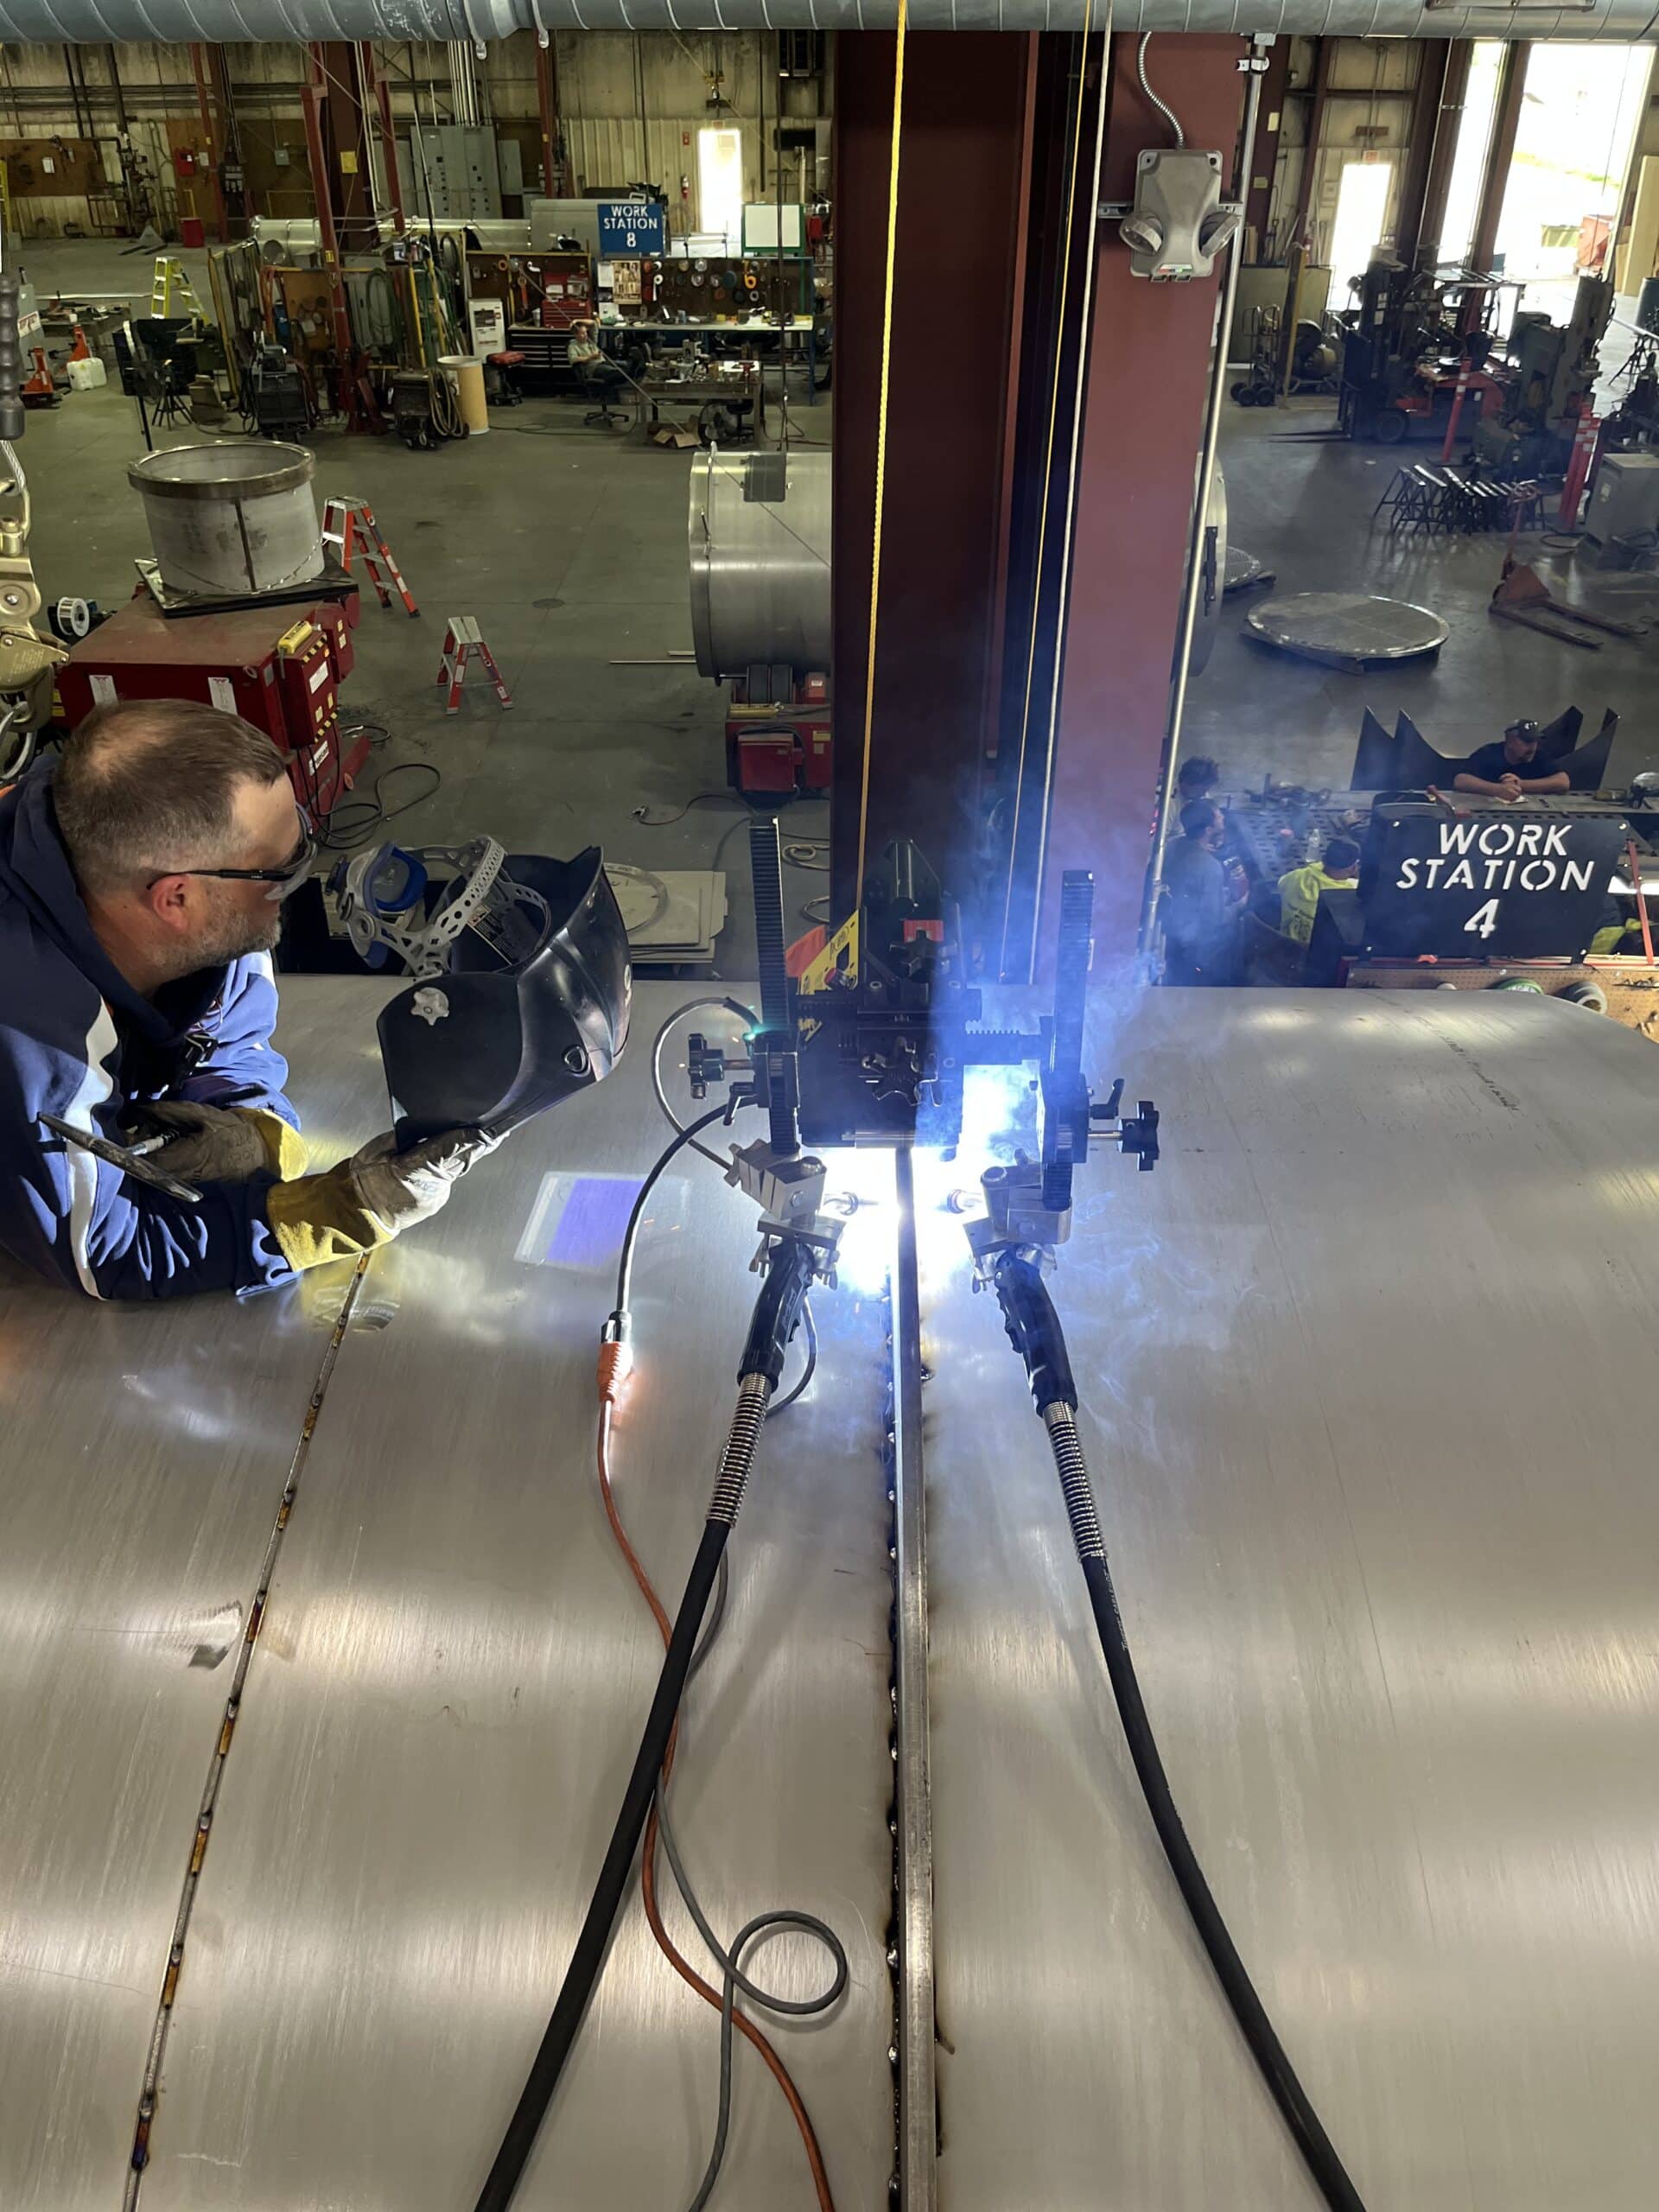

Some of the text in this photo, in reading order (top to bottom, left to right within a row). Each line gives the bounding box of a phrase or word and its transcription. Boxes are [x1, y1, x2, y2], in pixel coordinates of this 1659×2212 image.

[611, 206, 648, 217] WORK
[604, 218, 658, 230] STATION
[626, 232, 637, 248] 8
[1440, 823, 1573, 855] WORK
[1395, 858, 1595, 891] STATION
[1463, 899, 1500, 939] 4
